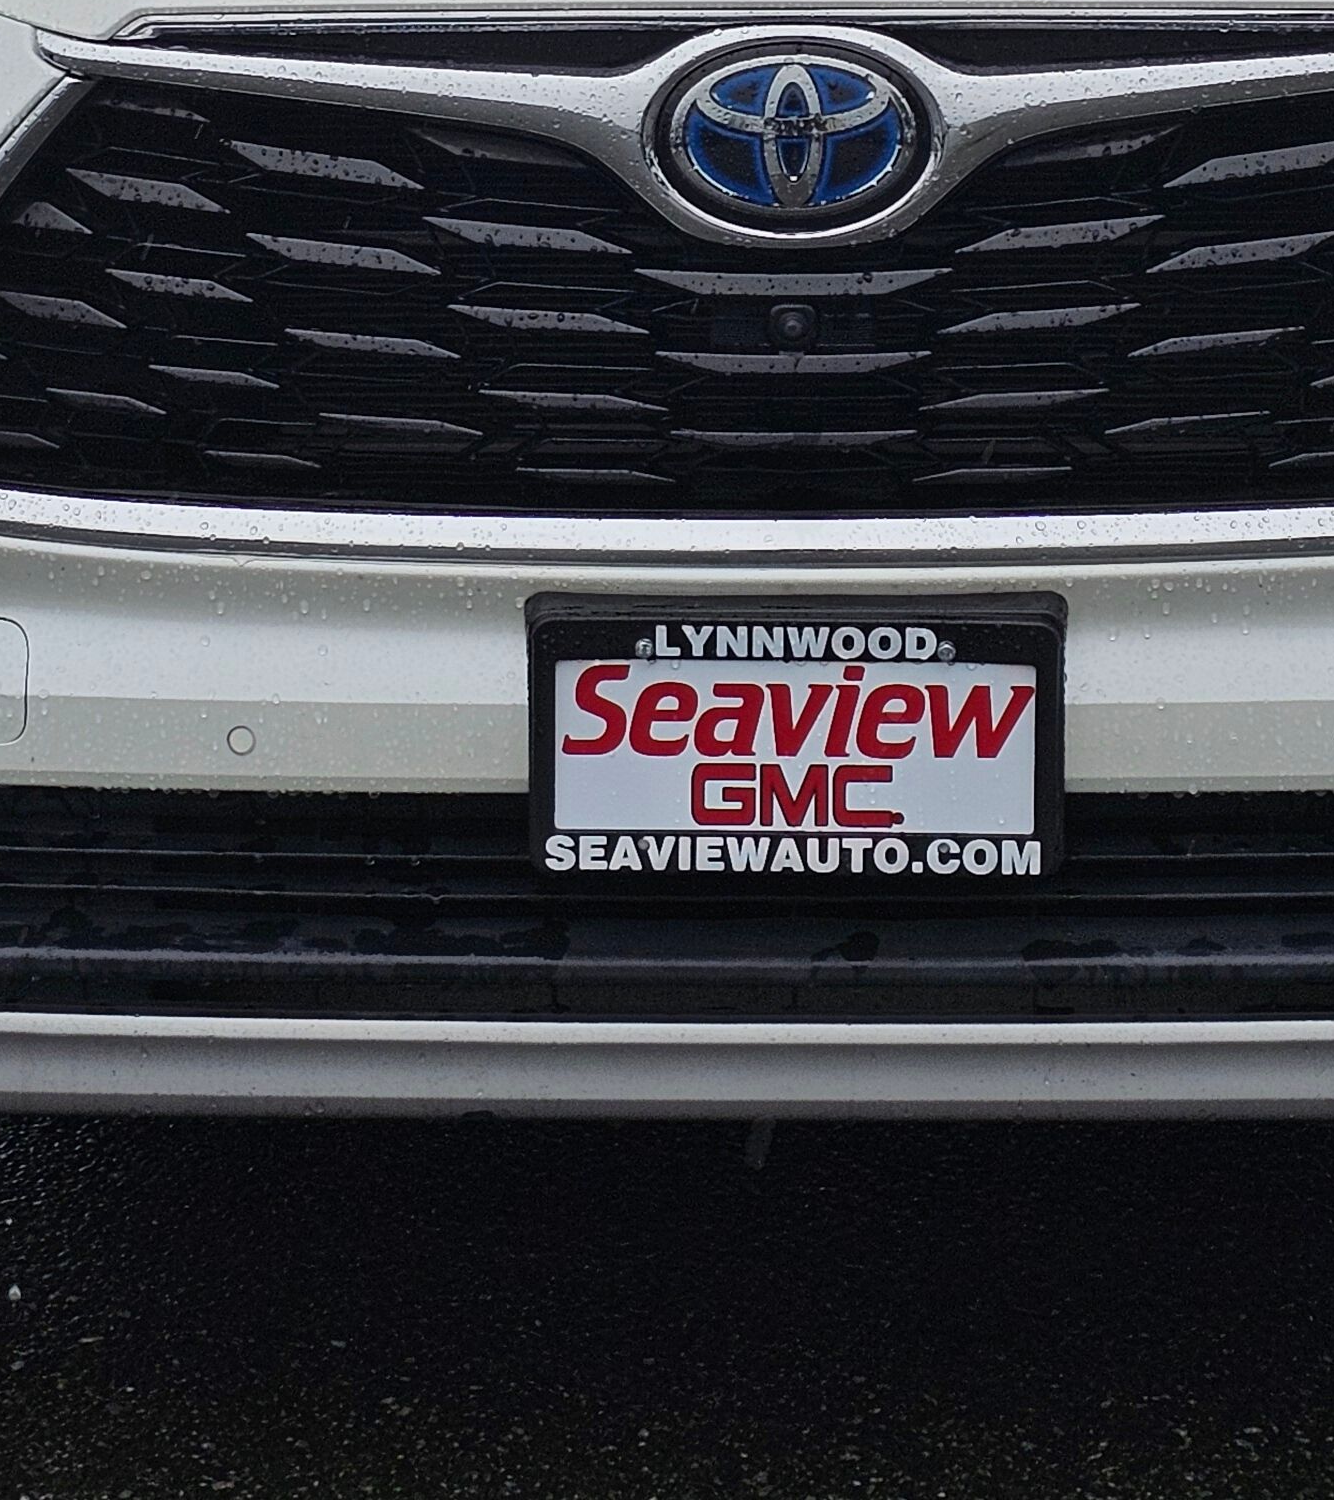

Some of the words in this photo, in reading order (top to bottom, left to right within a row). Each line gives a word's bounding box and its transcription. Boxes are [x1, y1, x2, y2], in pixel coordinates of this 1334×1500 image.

[655, 625, 938, 661] LYNNWOOD
[562, 665, 1034, 759] Seaview
[690, 762, 904, 828] GMC
[544, 834, 1041, 877] SEAVIEWAUTO.COM
